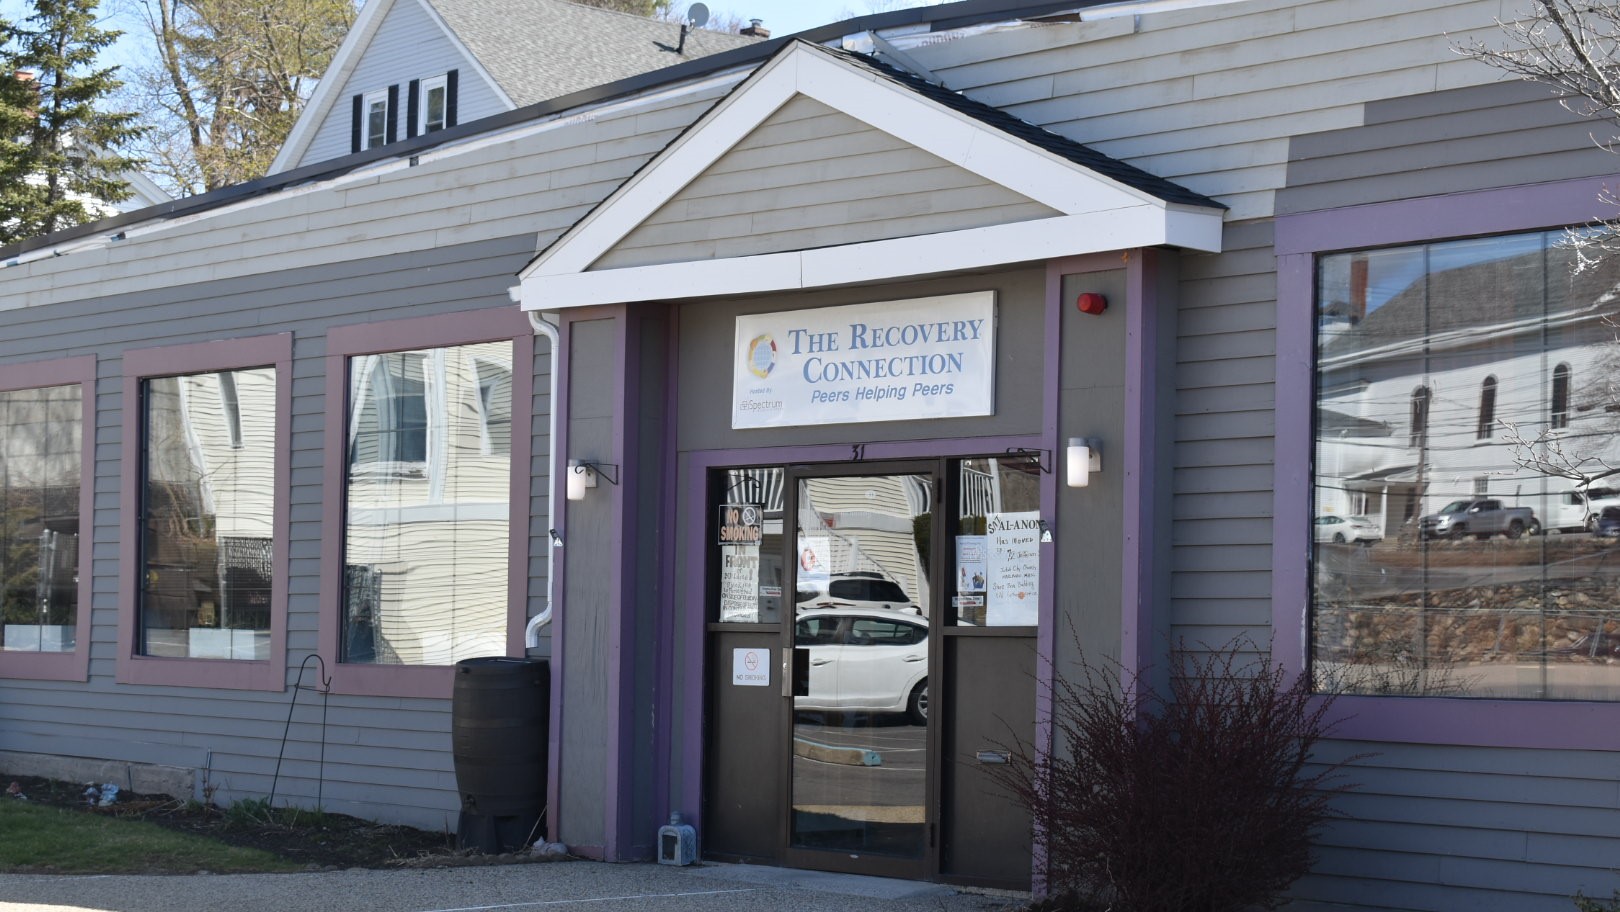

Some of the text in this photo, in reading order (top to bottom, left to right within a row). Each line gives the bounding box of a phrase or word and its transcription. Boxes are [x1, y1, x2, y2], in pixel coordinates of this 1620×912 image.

[788, 318, 985, 355] THE RECOVERY
[802, 352, 964, 384] CONNECTION
[811, 382, 954, 404] Peers Helping Peers
[749, 399, 783, 412] Spectrum
[852, 444, 865, 461] 31
[727, 509, 739, 525] NO
[720, 526, 759, 541] SMOKING
